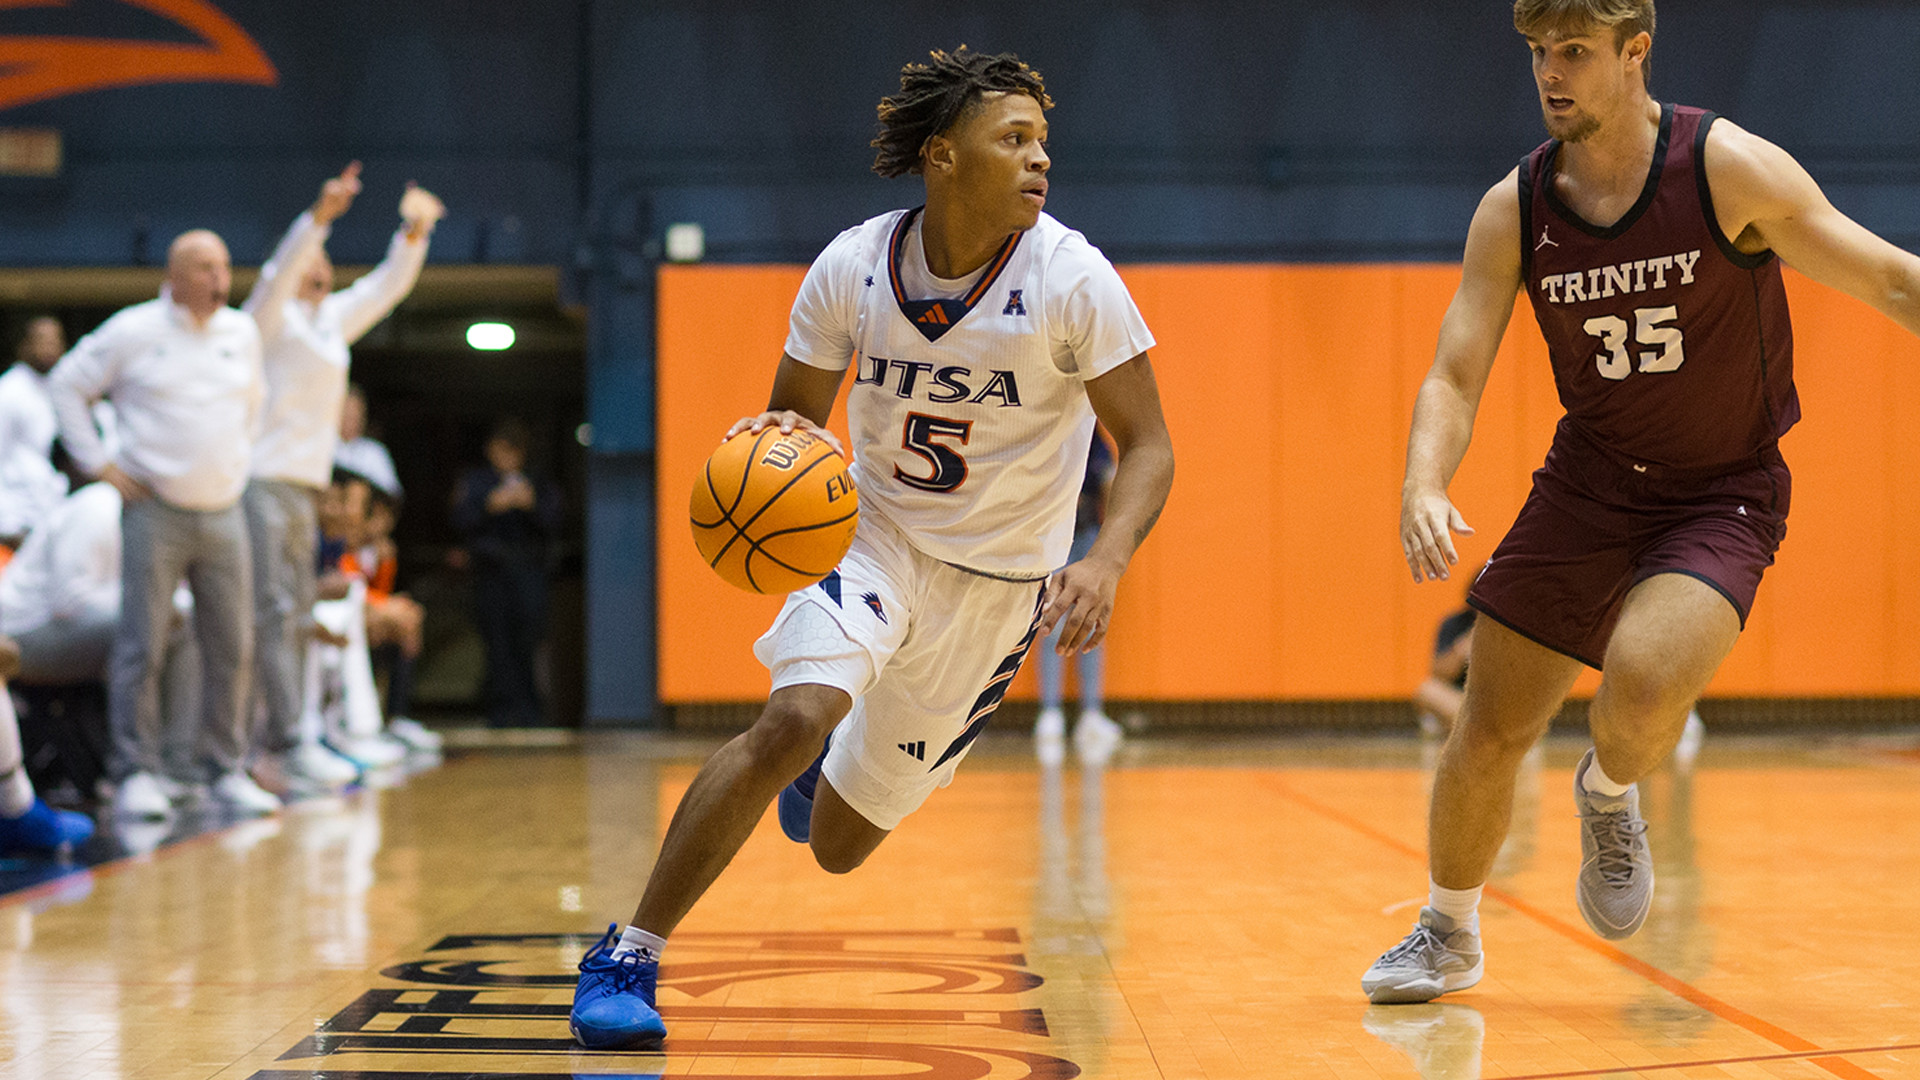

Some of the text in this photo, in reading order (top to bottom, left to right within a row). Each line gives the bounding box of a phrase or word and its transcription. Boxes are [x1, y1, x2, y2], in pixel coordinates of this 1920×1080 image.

[1541, 249, 1701, 303] TRINITY
[1582, 305, 1685, 381] 35
[854, 354, 1023, 408] UTSA
[893, 411, 974, 493] 5
